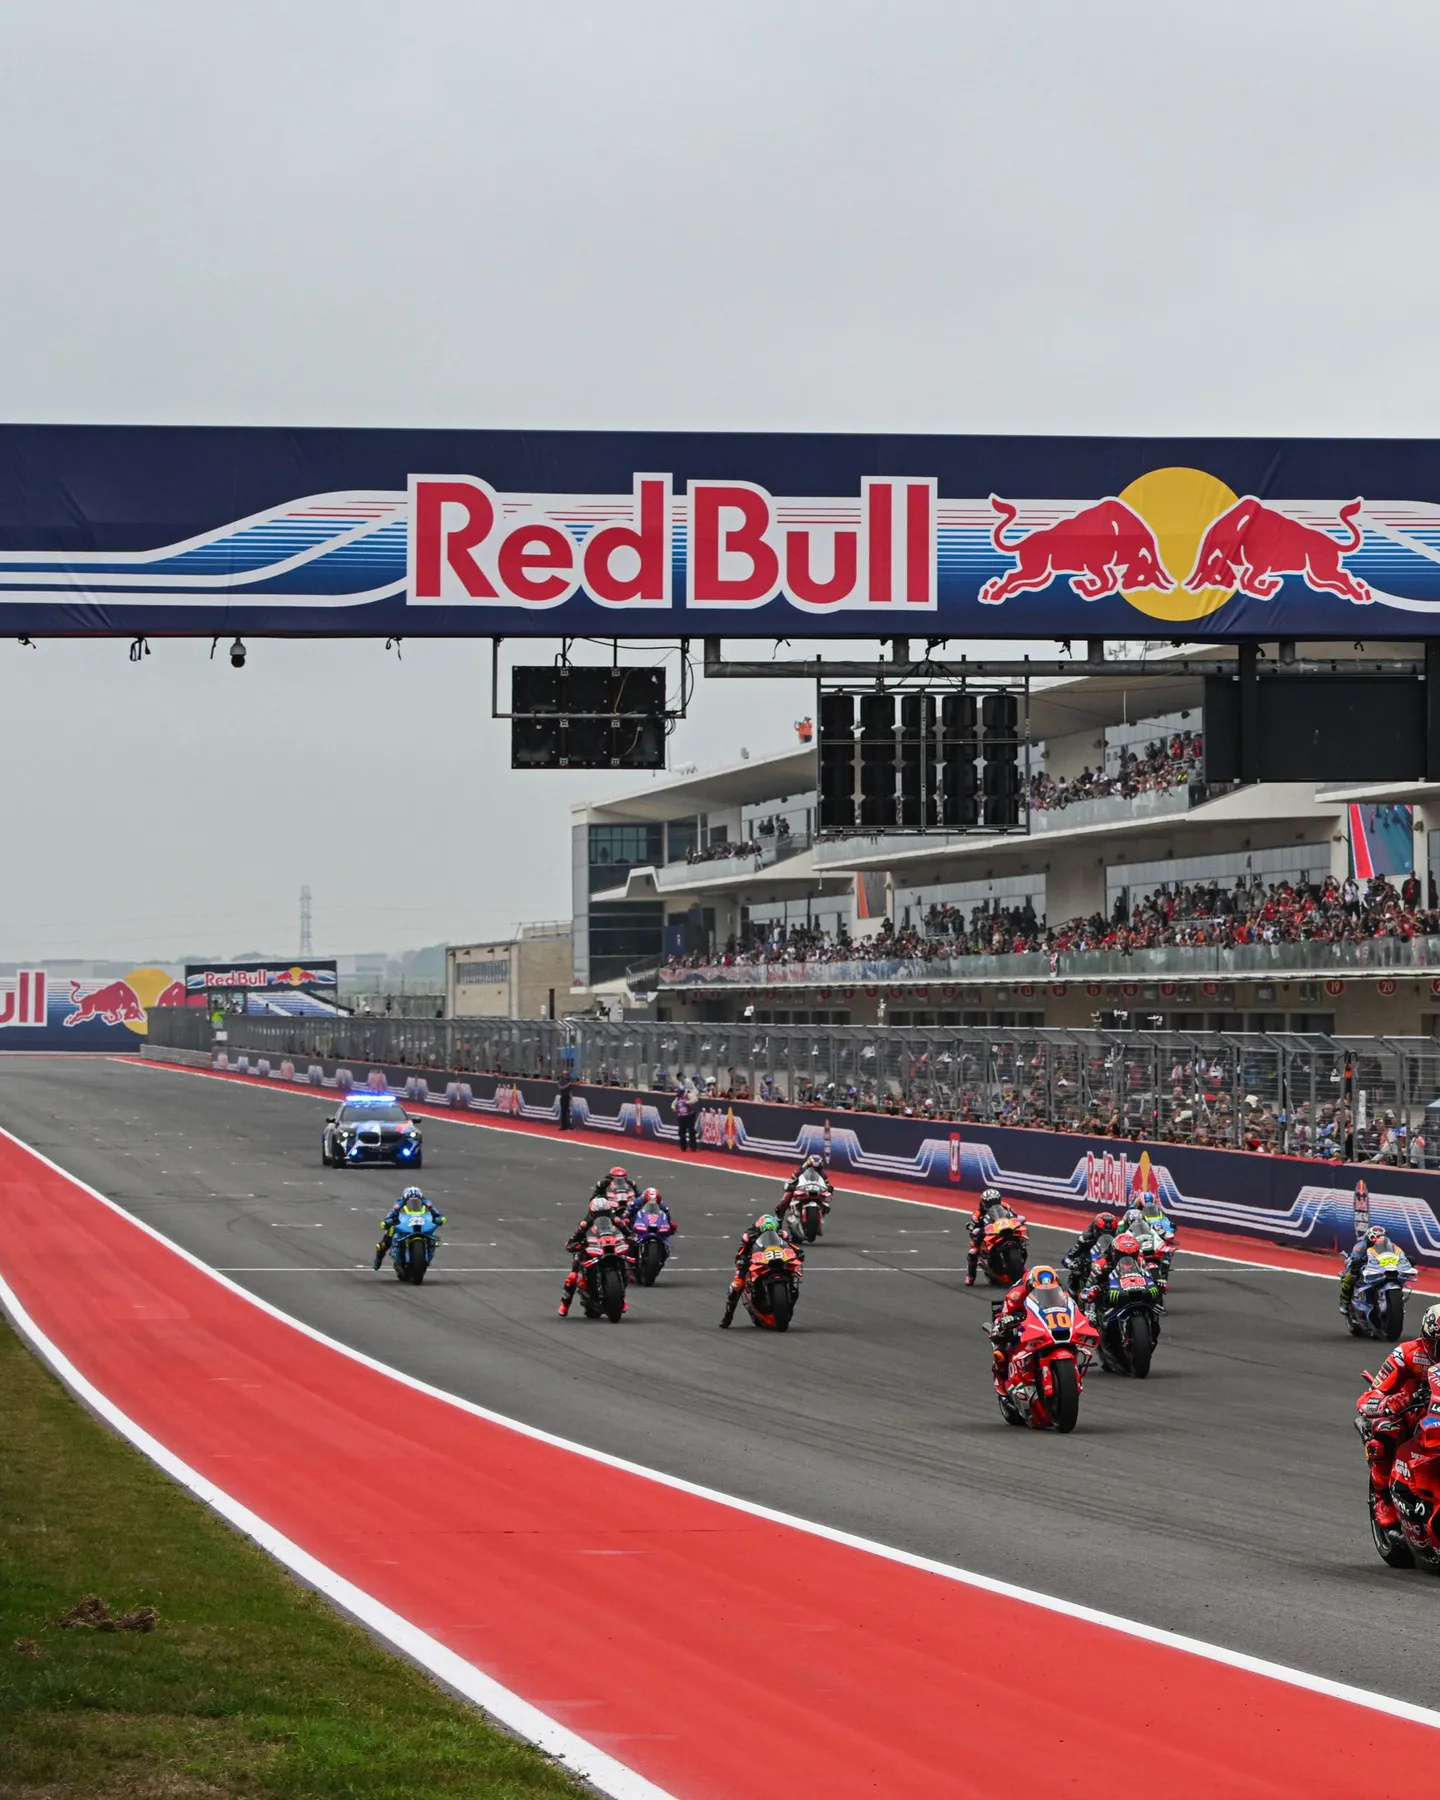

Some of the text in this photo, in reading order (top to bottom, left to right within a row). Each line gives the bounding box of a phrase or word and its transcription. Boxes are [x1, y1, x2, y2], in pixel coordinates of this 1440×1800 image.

[415, 480, 932, 604] Red Bull
[205, 970, 267, 985] Red Bull
[1330, 978, 1341, 992] 19
[1382, 978, 1394, 992] 20
[1087, 1153, 1127, 1206] Red Bull
[1045, 1312, 1072, 1330] 10
